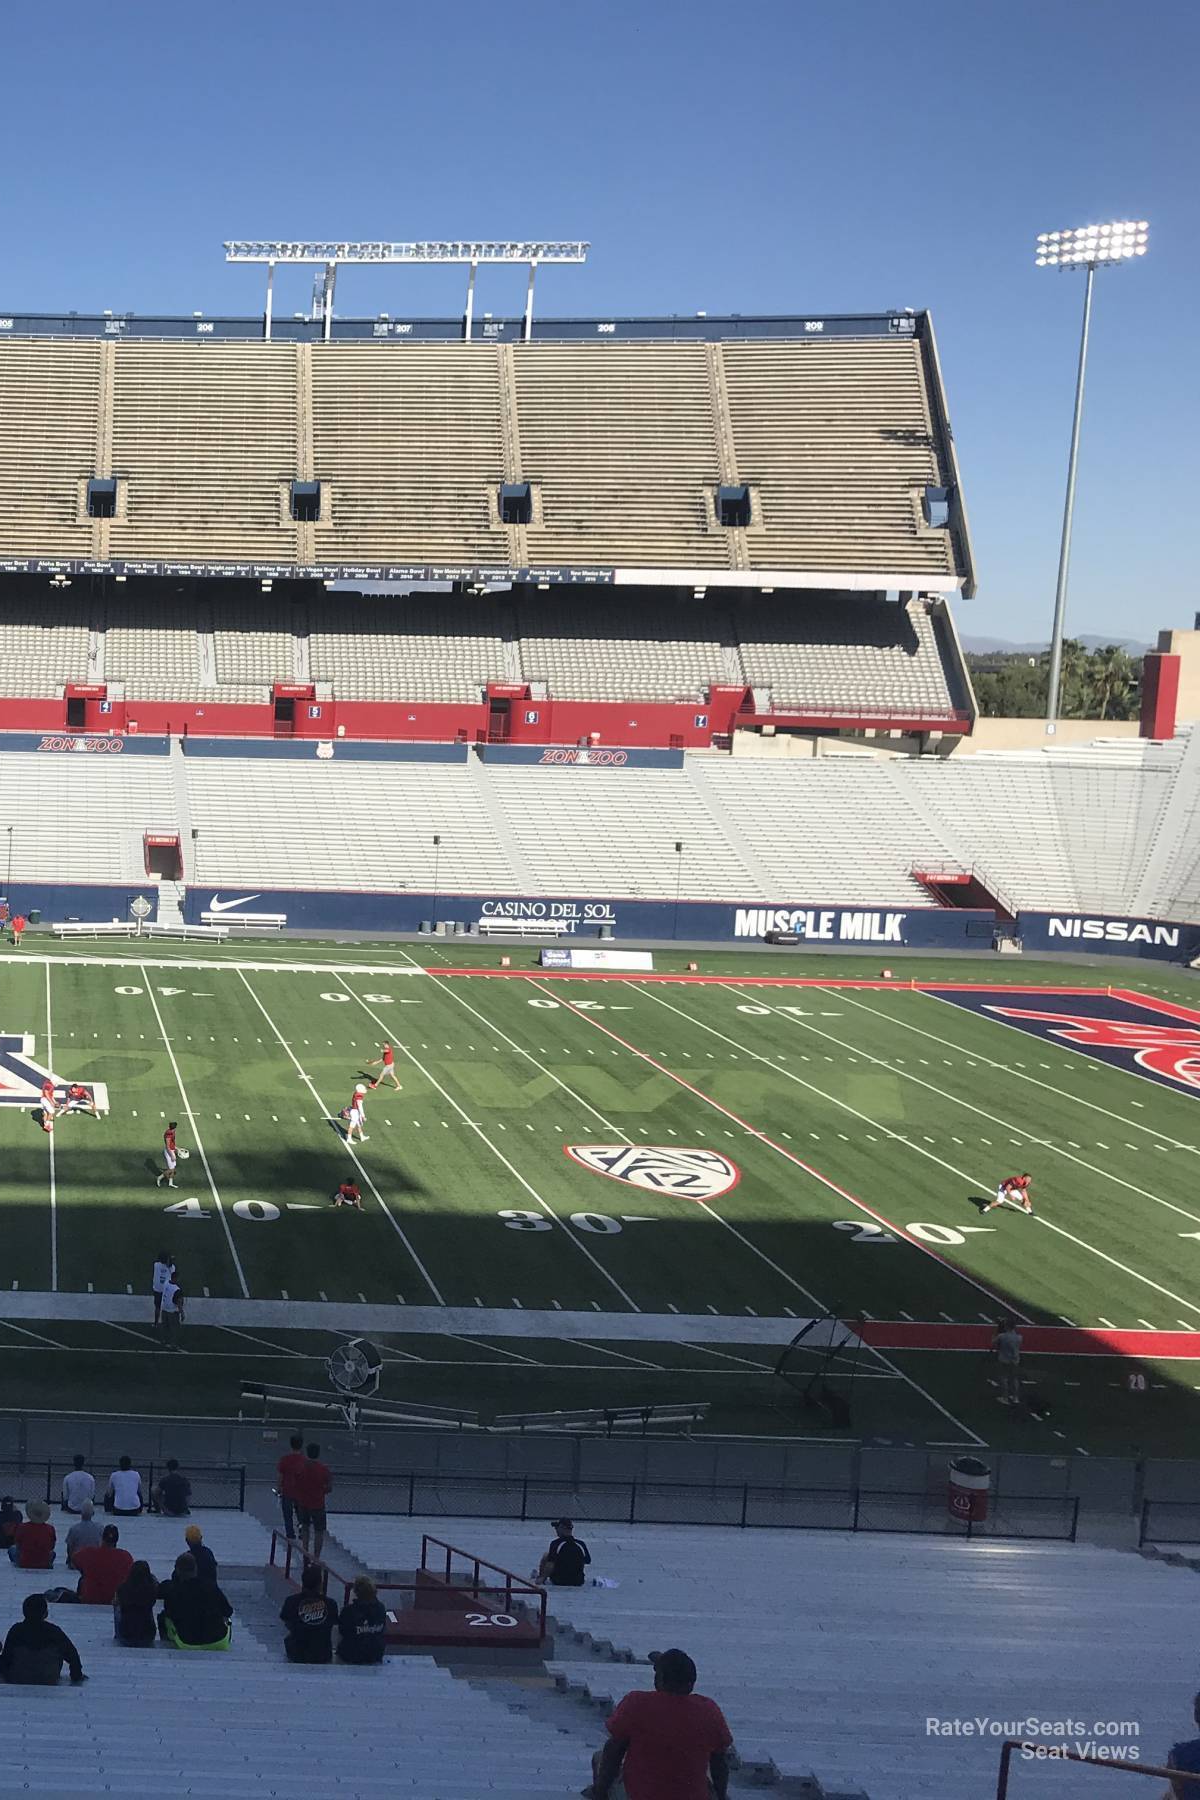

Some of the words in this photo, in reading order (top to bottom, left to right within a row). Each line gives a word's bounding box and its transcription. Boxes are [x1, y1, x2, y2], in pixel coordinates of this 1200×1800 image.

[482, 901, 547, 917] CASINO
[550, 903, 581, 918] DEL
[584, 904, 616, 919] SOL
[734, 909, 836, 939] MUSCLE
[839, 912, 906, 941] MILK
[1048, 918, 1180, 946] NISSAN
[1129, 1374, 1145, 1390] 20
[464, 1613, 519, 1628] 20
